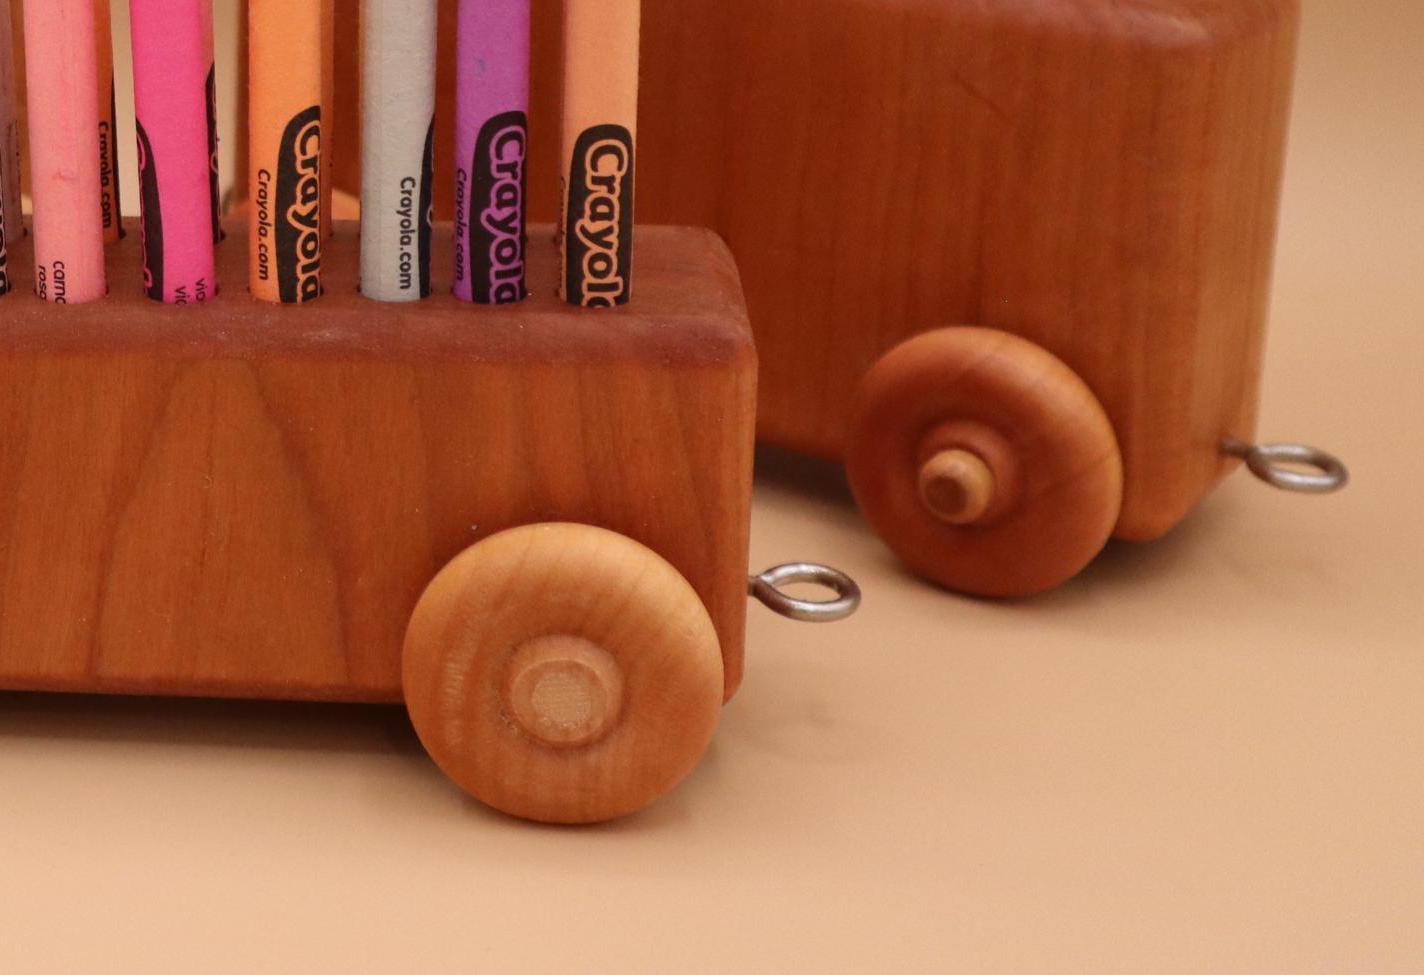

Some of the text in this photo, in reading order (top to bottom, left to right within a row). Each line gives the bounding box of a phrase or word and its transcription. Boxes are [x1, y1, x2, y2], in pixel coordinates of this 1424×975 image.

[256, 168, 272, 281] Crayola.com
[396, 176, 416, 290] Crayola.com
[453, 167, 467, 281] Crayola.com
[480, 125, 526, 305] Crayola
